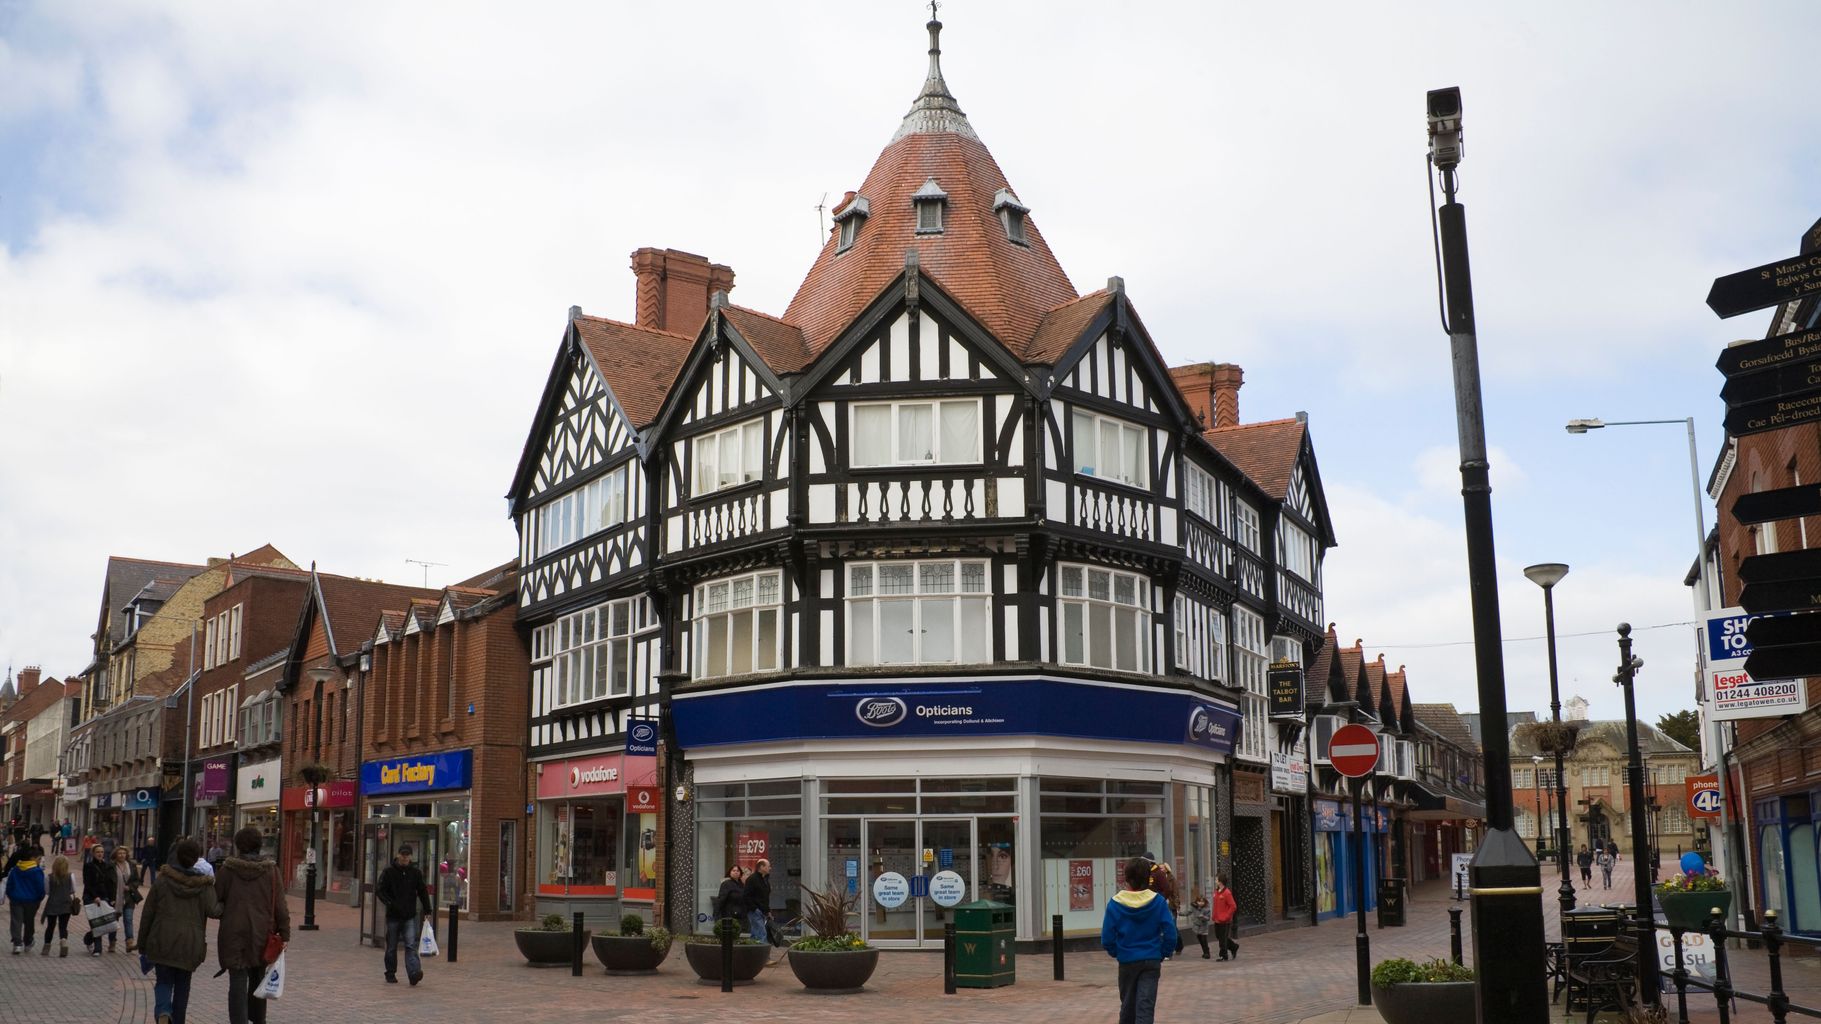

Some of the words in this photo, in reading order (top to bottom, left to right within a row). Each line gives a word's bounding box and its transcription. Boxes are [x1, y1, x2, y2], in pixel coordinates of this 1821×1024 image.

[1761, 270, 1770, 279] St
[1775, 262, 1807, 275] Marys
[1776, 272, 1810, 287] Eglwys
[1784, 333, 1821, 347] Bus/Ra
[1739, 349, 1793, 369] Gorsafoedd
[1747, 419, 1766, 428] Cae
[1720, 634, 1747, 650] TO
[1714, 672, 1748, 690] Legat
[1716, 689, 1750, 700] 01244
[1754, 684, 1796, 696] 408200
[1718, 696, 1797, 708] www.legatowen.co.uk
[864, 702, 896, 719] Boots
[916, 705, 973, 718] Opticians
[381, 764, 401, 785] Card
[402, 762, 436, 785] Factory
[581, 765, 618, 783] vodafone
[1693, 781, 1719, 789] phone
[747, 840, 765, 853] £79
[1077, 866, 1092, 876] £60
[963, 943, 976, 955] W
[1664, 953, 1706, 966] CSH
